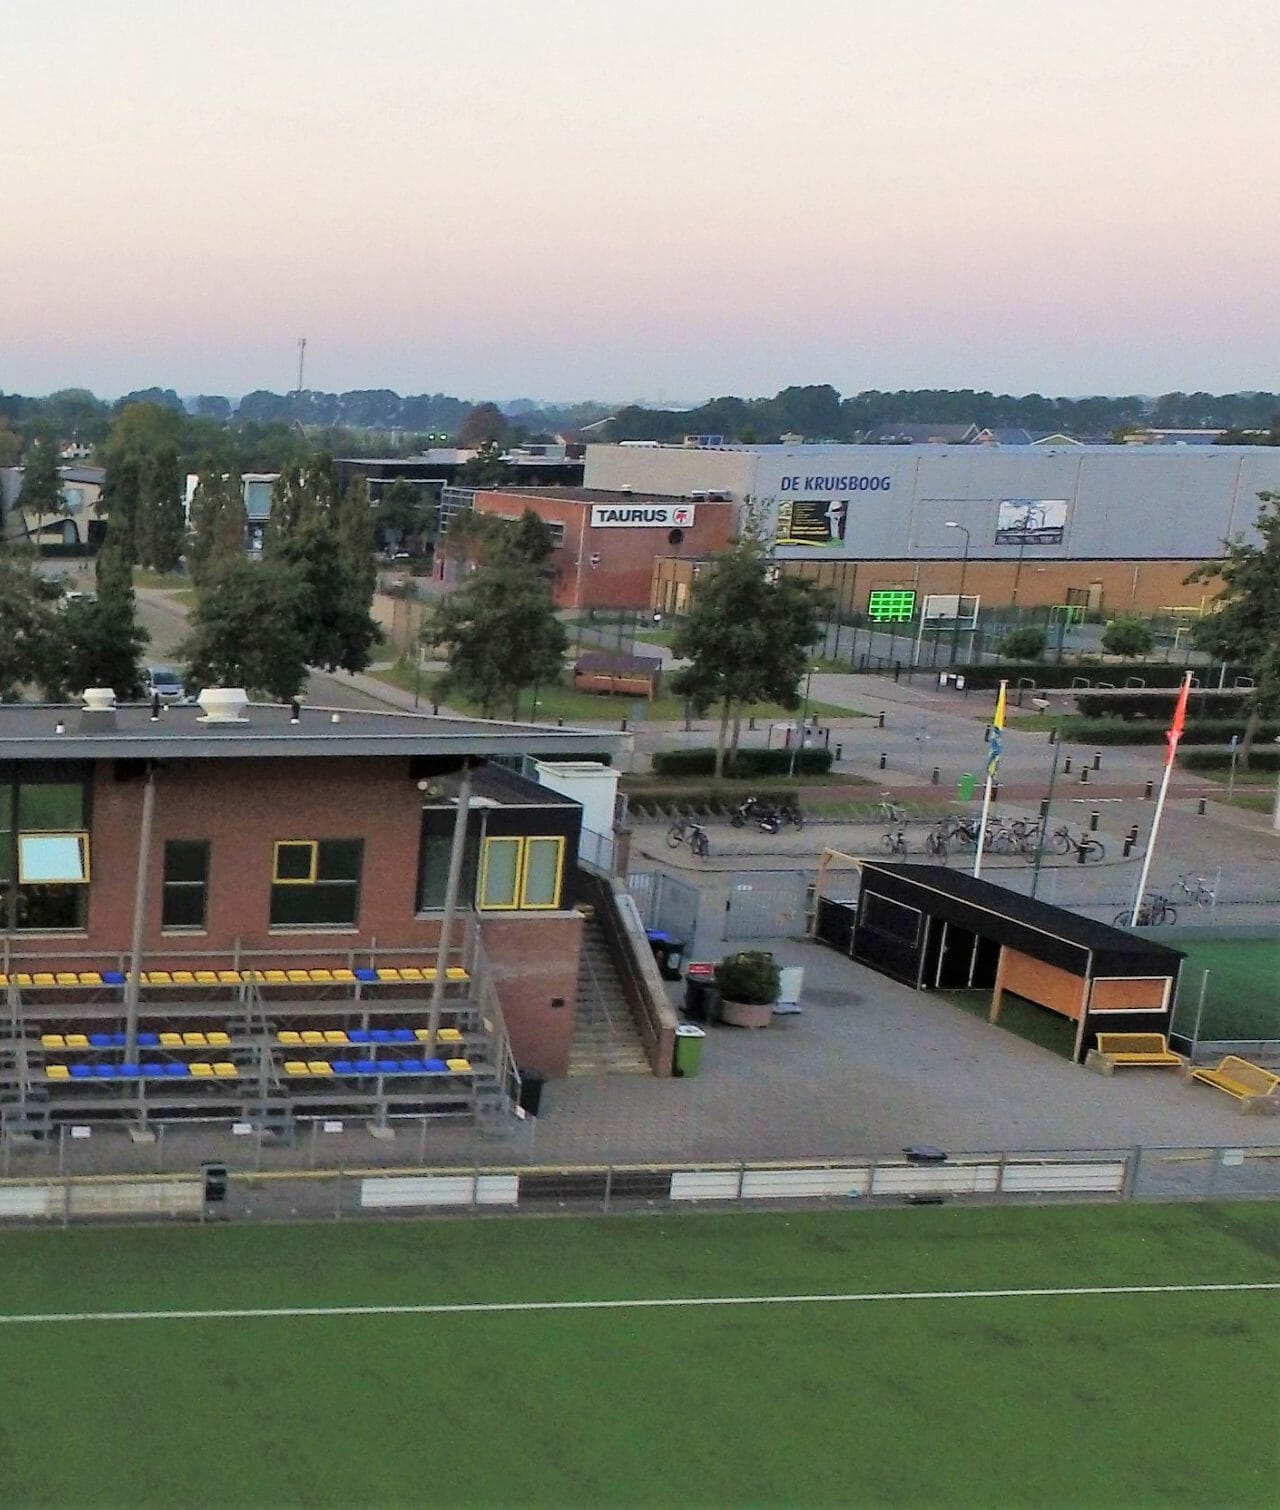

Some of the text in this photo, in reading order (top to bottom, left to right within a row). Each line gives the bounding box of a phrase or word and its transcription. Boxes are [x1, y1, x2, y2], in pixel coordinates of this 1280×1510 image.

[781, 476, 890, 491] DE KRUISBOOG
[596, 509, 667, 522] TAURUS
